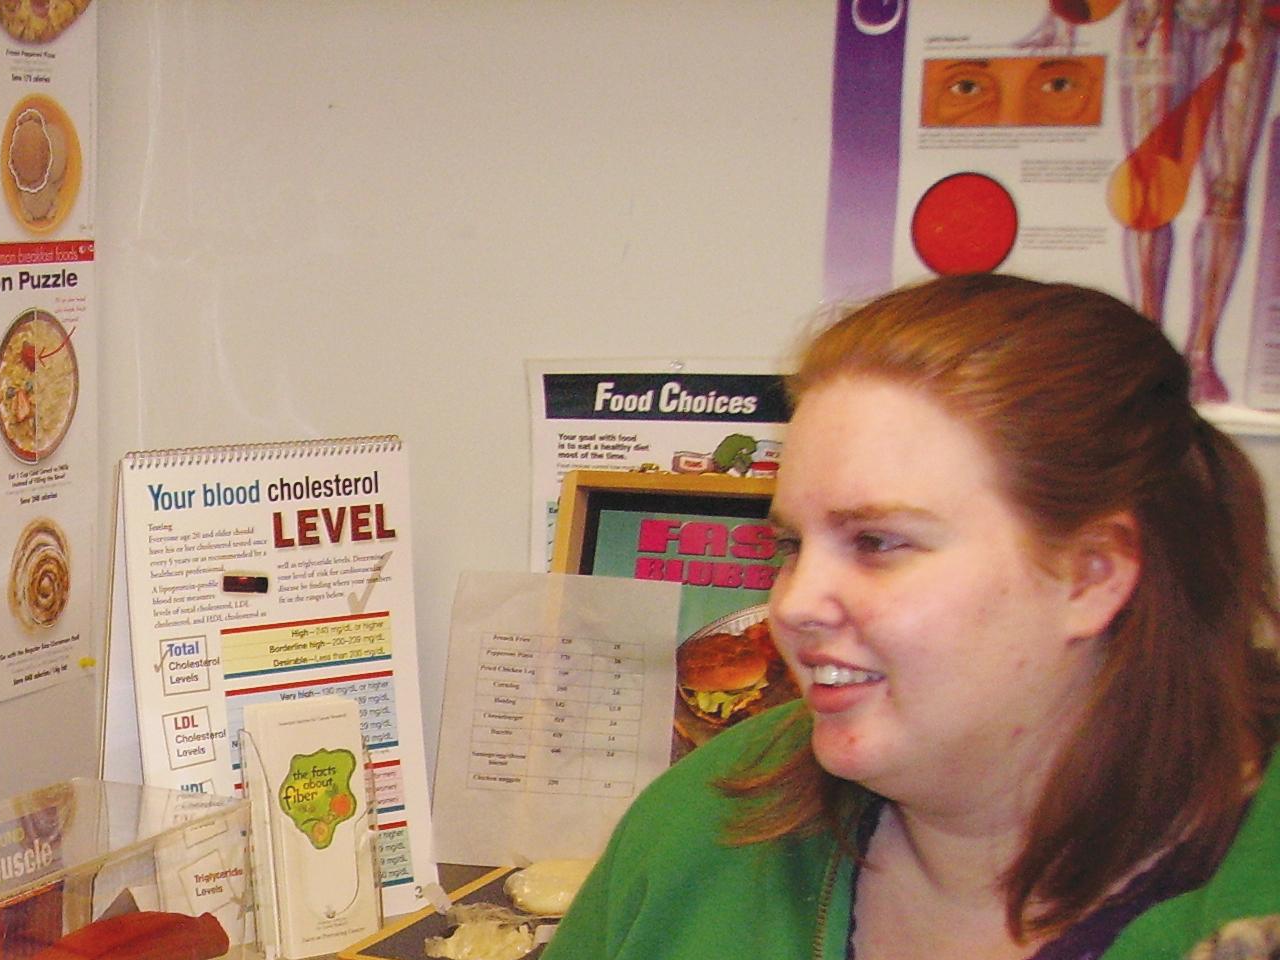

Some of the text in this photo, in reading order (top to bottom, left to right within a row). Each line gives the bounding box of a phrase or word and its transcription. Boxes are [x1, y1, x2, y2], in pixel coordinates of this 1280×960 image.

[18, 248, 53, 265] breakfast
[55, 246, 79, 261] foods
[18, 269, 78, 290] Puzzle
[594, 382, 758, 414] Food Choices
[558, 433, 577, 441] Your
[579, 434, 597, 443] goal
[600, 443, 632, 452] healthy
[147, 471, 379, 511] Your blood cholesterol
[272, 503, 396, 549] LEVEL
[167, 641, 200, 658] Total
[168, 656, 220, 671] Cholesterol
[169, 673, 199, 685] Levels
[174, 714, 199, 731] LDL
[175, 729, 226, 744] Cholesterol
[176, 746, 206, 758] Levels
[293, 765, 336, 780] the facts
[303, 777, 333, 790] about
[283, 785, 318, 811] fiber
[194, 867, 243, 884] Triglyceride
[195, 885, 224, 897] Levels
